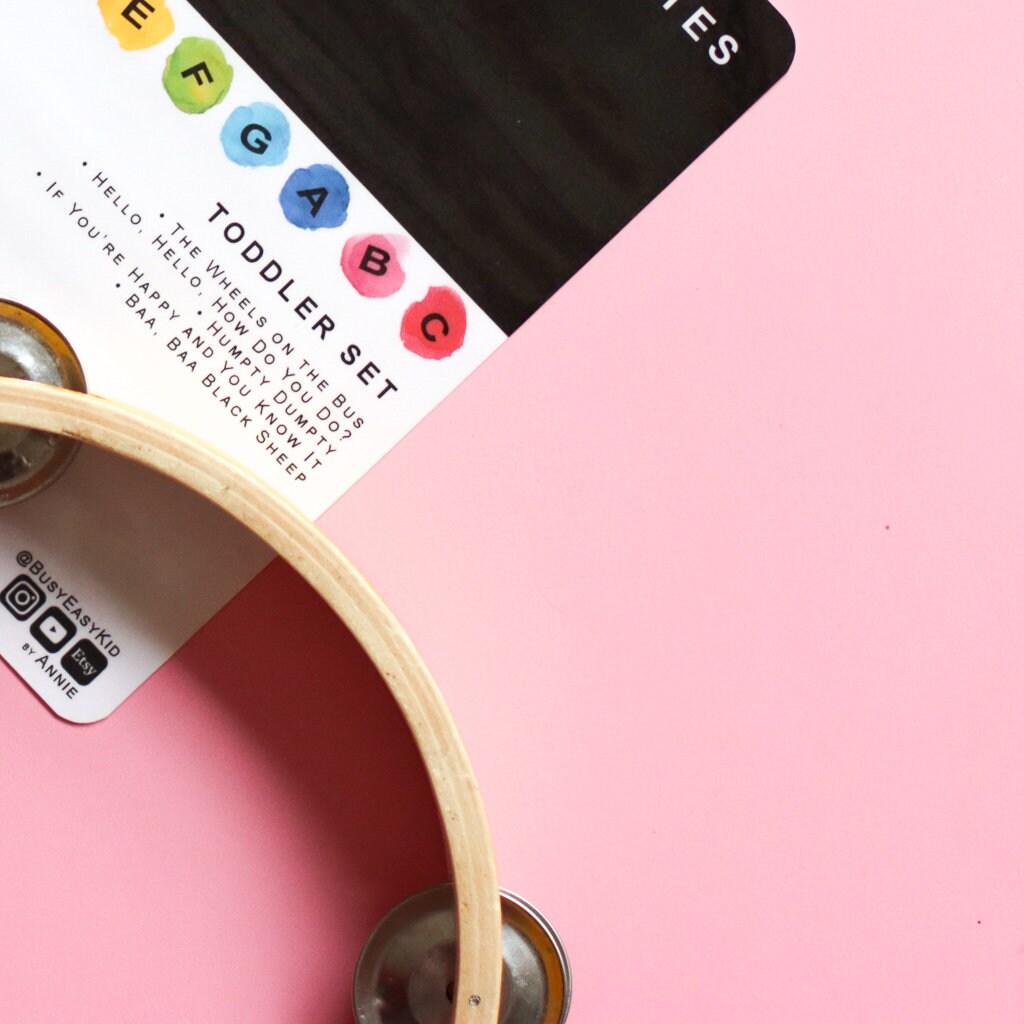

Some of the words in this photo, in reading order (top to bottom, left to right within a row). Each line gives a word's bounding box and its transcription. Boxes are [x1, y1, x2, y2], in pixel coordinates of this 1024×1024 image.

[180, 60, 215, 86] F
[240, 122, 273, 156] G
[296, 185, 330, 218] A
[358, 244, 391, 276] B
[420, 312, 450, 343] C
[207, 201, 336, 341] TODDLER
[340, 344, 399, 400] SET
[45, 181, 65, 199] IF
[127, 266, 181, 322] HAPPY
[181, 327, 215, 360] AND
[219, 359, 252, 398] YOU
[254, 399, 302, 449] KNOW
[303, 451, 324, 471] IT
[91, 171, 144, 235] HELLO,
[151, 234, 203, 297] HELLO,
[211, 296, 250, 337] HOW
[251, 338, 276, 366] DO
[281, 367, 314, 405] YOU
[316, 406, 353, 442] DO?
[170, 222, 203, 259] THE
[205, 259, 268, 329] WHEELS
[271, 332, 296, 356] ON
[299, 359, 330, 393] THE
[332, 393, 365, 430] BUS
[206, 320, 271, 387] HUMPTY
[273, 389, 338, 457] DUMPTY
[166, 335, 198, 374] BAA
[201, 372, 253, 429] BLACK
[255, 429, 307, 483] SHEEP
[21, 642, 37, 656] BY
[34, 654, 79, 700] ANNIE
[70, 647, 98, 677] Etsy
